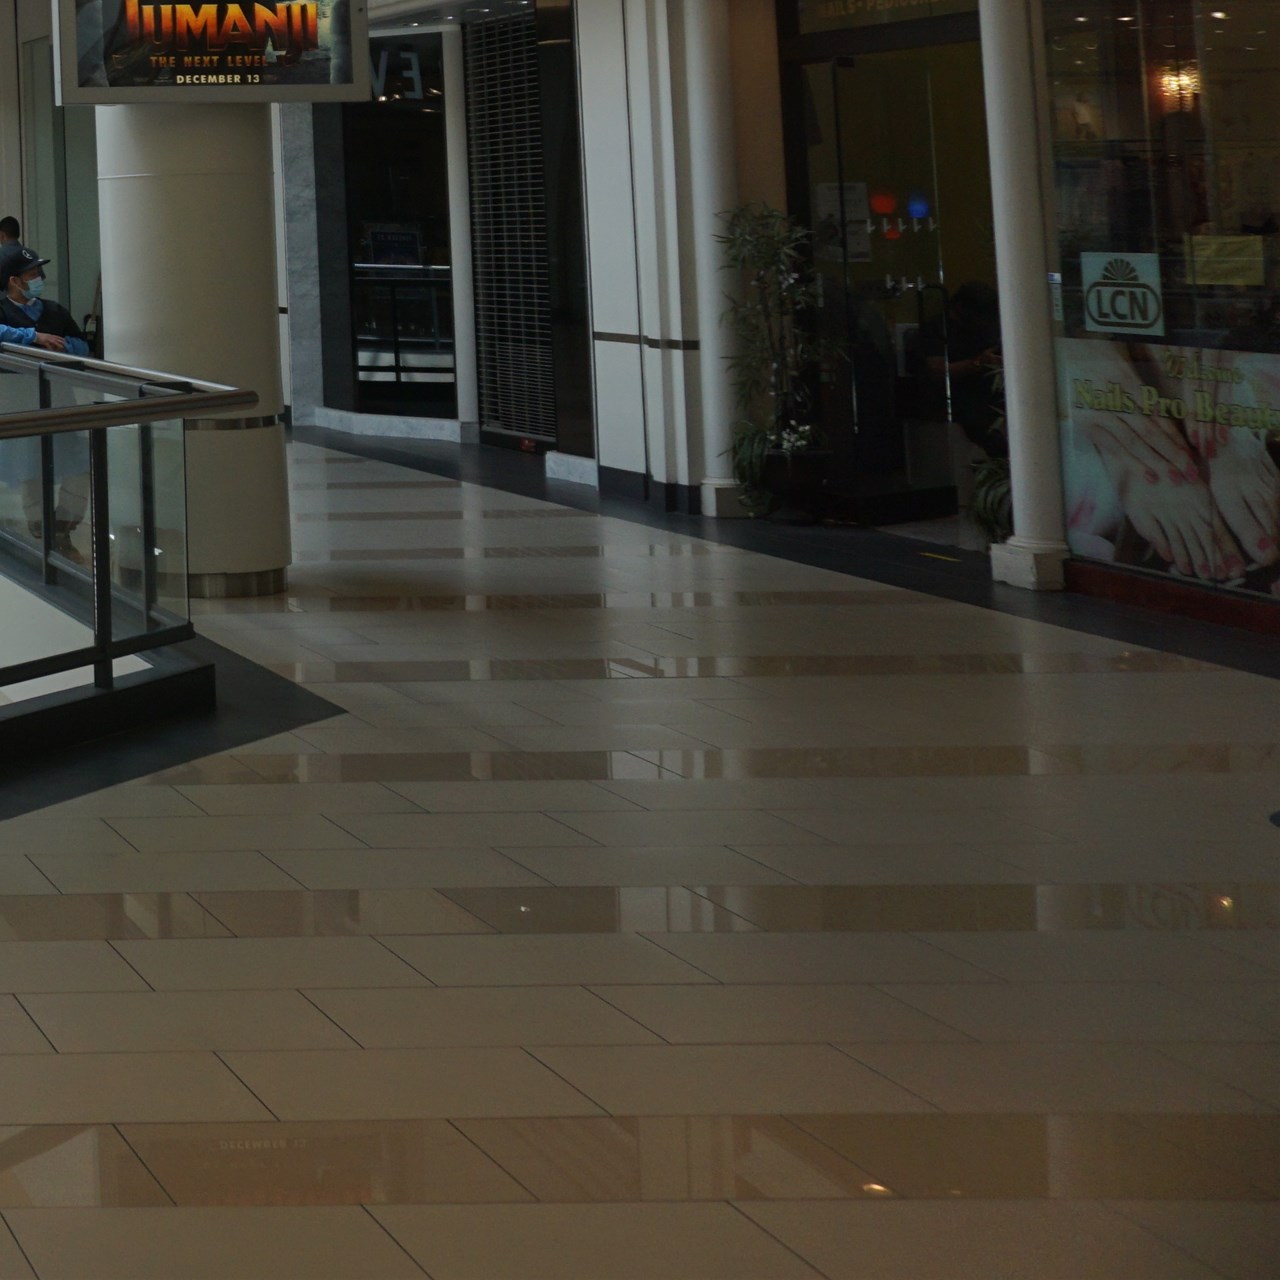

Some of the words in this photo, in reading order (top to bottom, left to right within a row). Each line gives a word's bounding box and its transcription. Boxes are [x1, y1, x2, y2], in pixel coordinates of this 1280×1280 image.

[150, 56, 175, 68] THE
[184, 56, 220, 67] NEXT
[227, 55, 269, 67] LEVEL
[176, 74, 241, 84] DECEMBER
[246, 74, 260, 84] 13
[1096, 289, 1148, 321] LCN
[1075, 378, 1136, 413] Nails
[1140, 384, 1188, 420] Pro
